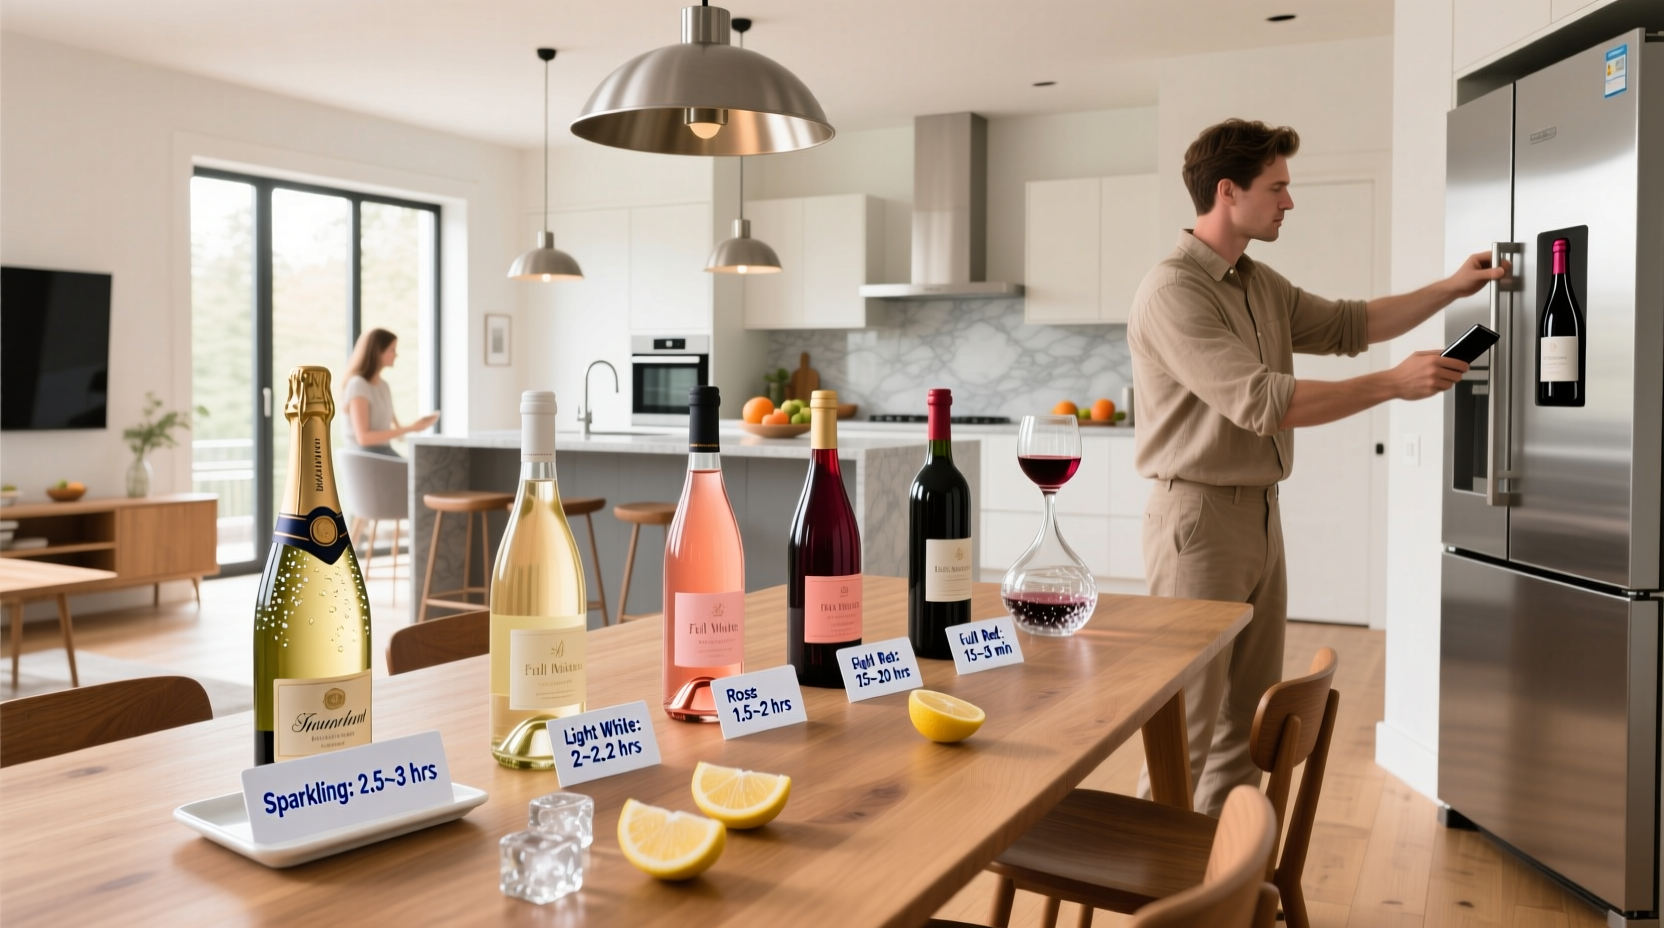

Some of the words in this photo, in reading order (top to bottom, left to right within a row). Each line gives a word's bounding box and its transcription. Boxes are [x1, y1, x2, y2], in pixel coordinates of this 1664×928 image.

[959, 630, 979, 646] Full
[893, 666, 911, 680] hrs
[732, 700, 769, 722] 1.5-2
[771, 698, 792, 714] hrs
[564, 724, 599, 747] Light
[571, 742, 616, 768] 2-2.2
[618, 739, 642, 757] hrs
[263, 780, 354, 818] Sparkling:
[358, 765, 406, 794] 2.5-3
[409, 762, 438, 784] hrs
